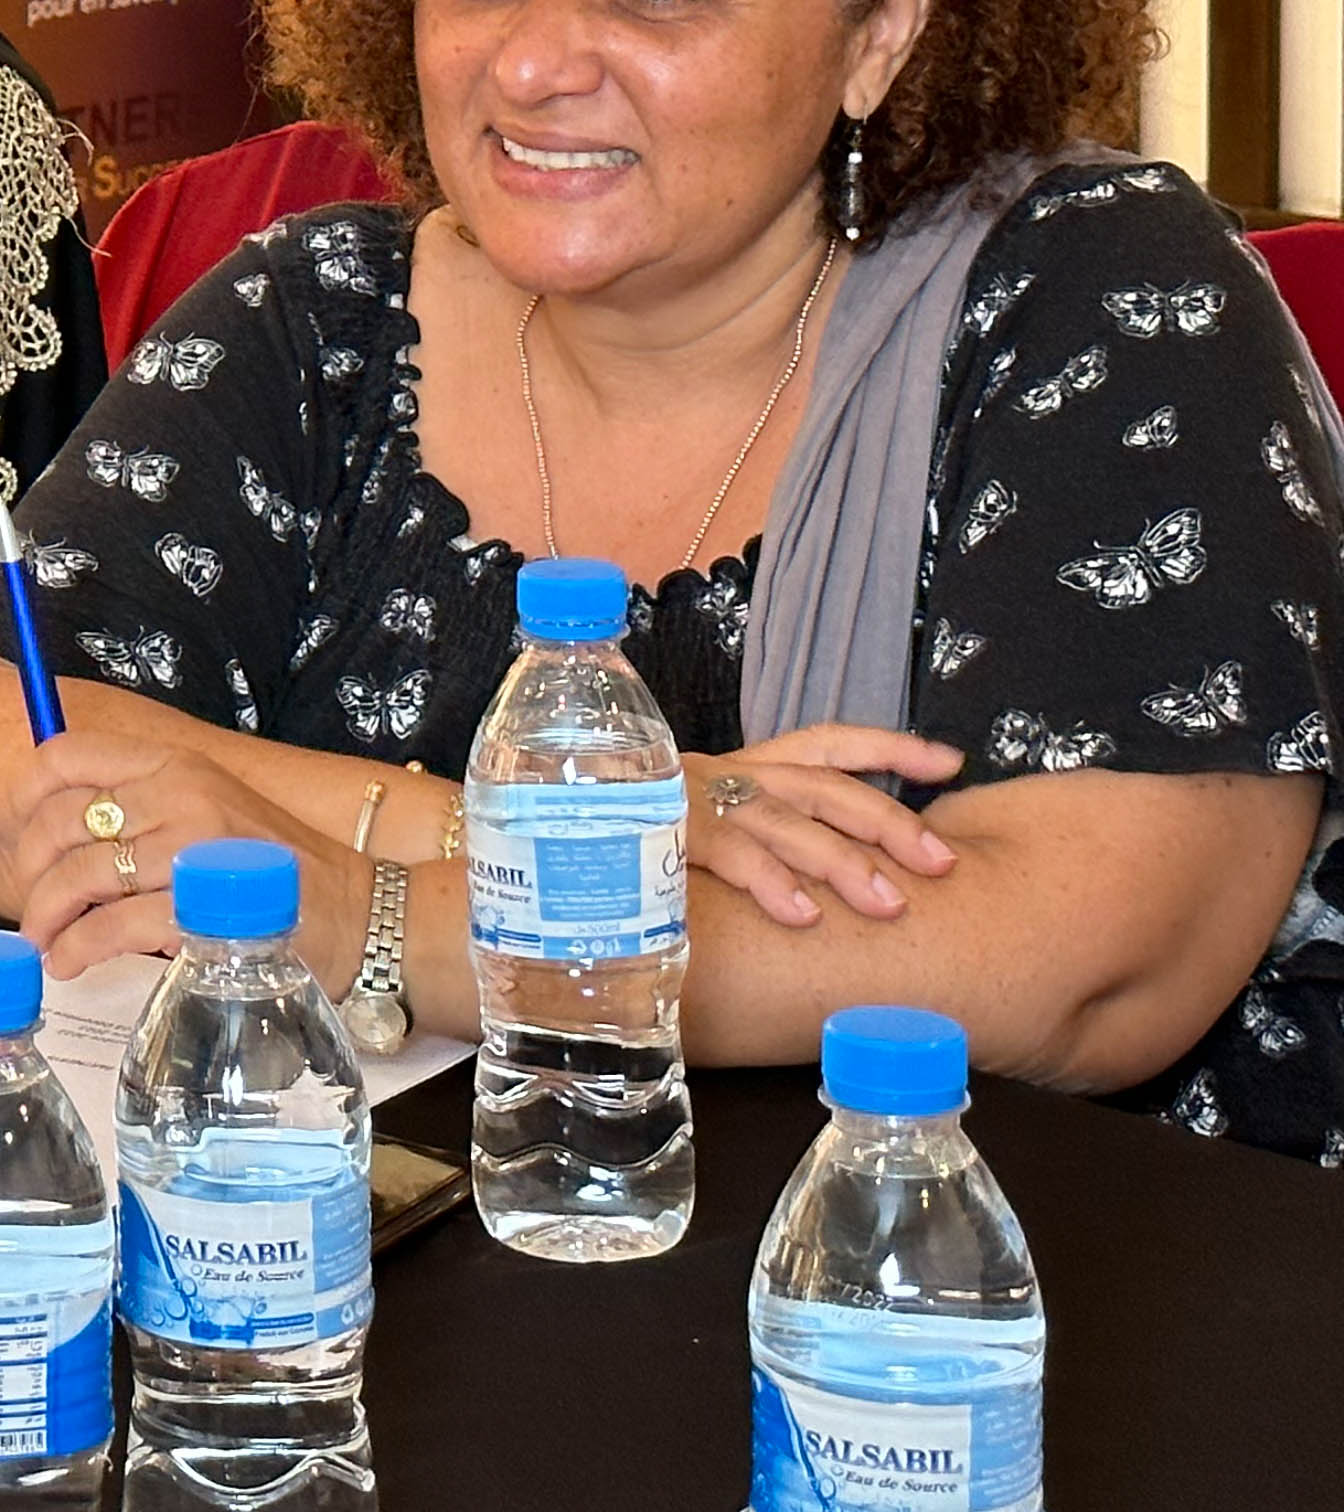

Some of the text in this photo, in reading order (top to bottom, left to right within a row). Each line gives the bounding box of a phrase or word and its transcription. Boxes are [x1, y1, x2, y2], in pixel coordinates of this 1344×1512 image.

[58, 92, 181, 146] TNER
[469, 857, 533, 889] LSABIL
[165, 1234, 309, 1265] SALSABIL
[203, 1268, 305, 1283] Eau de Source
[805, 1429, 964, 1474] SALSABIL
[845, 1470, 959, 1494] Eau de Source
